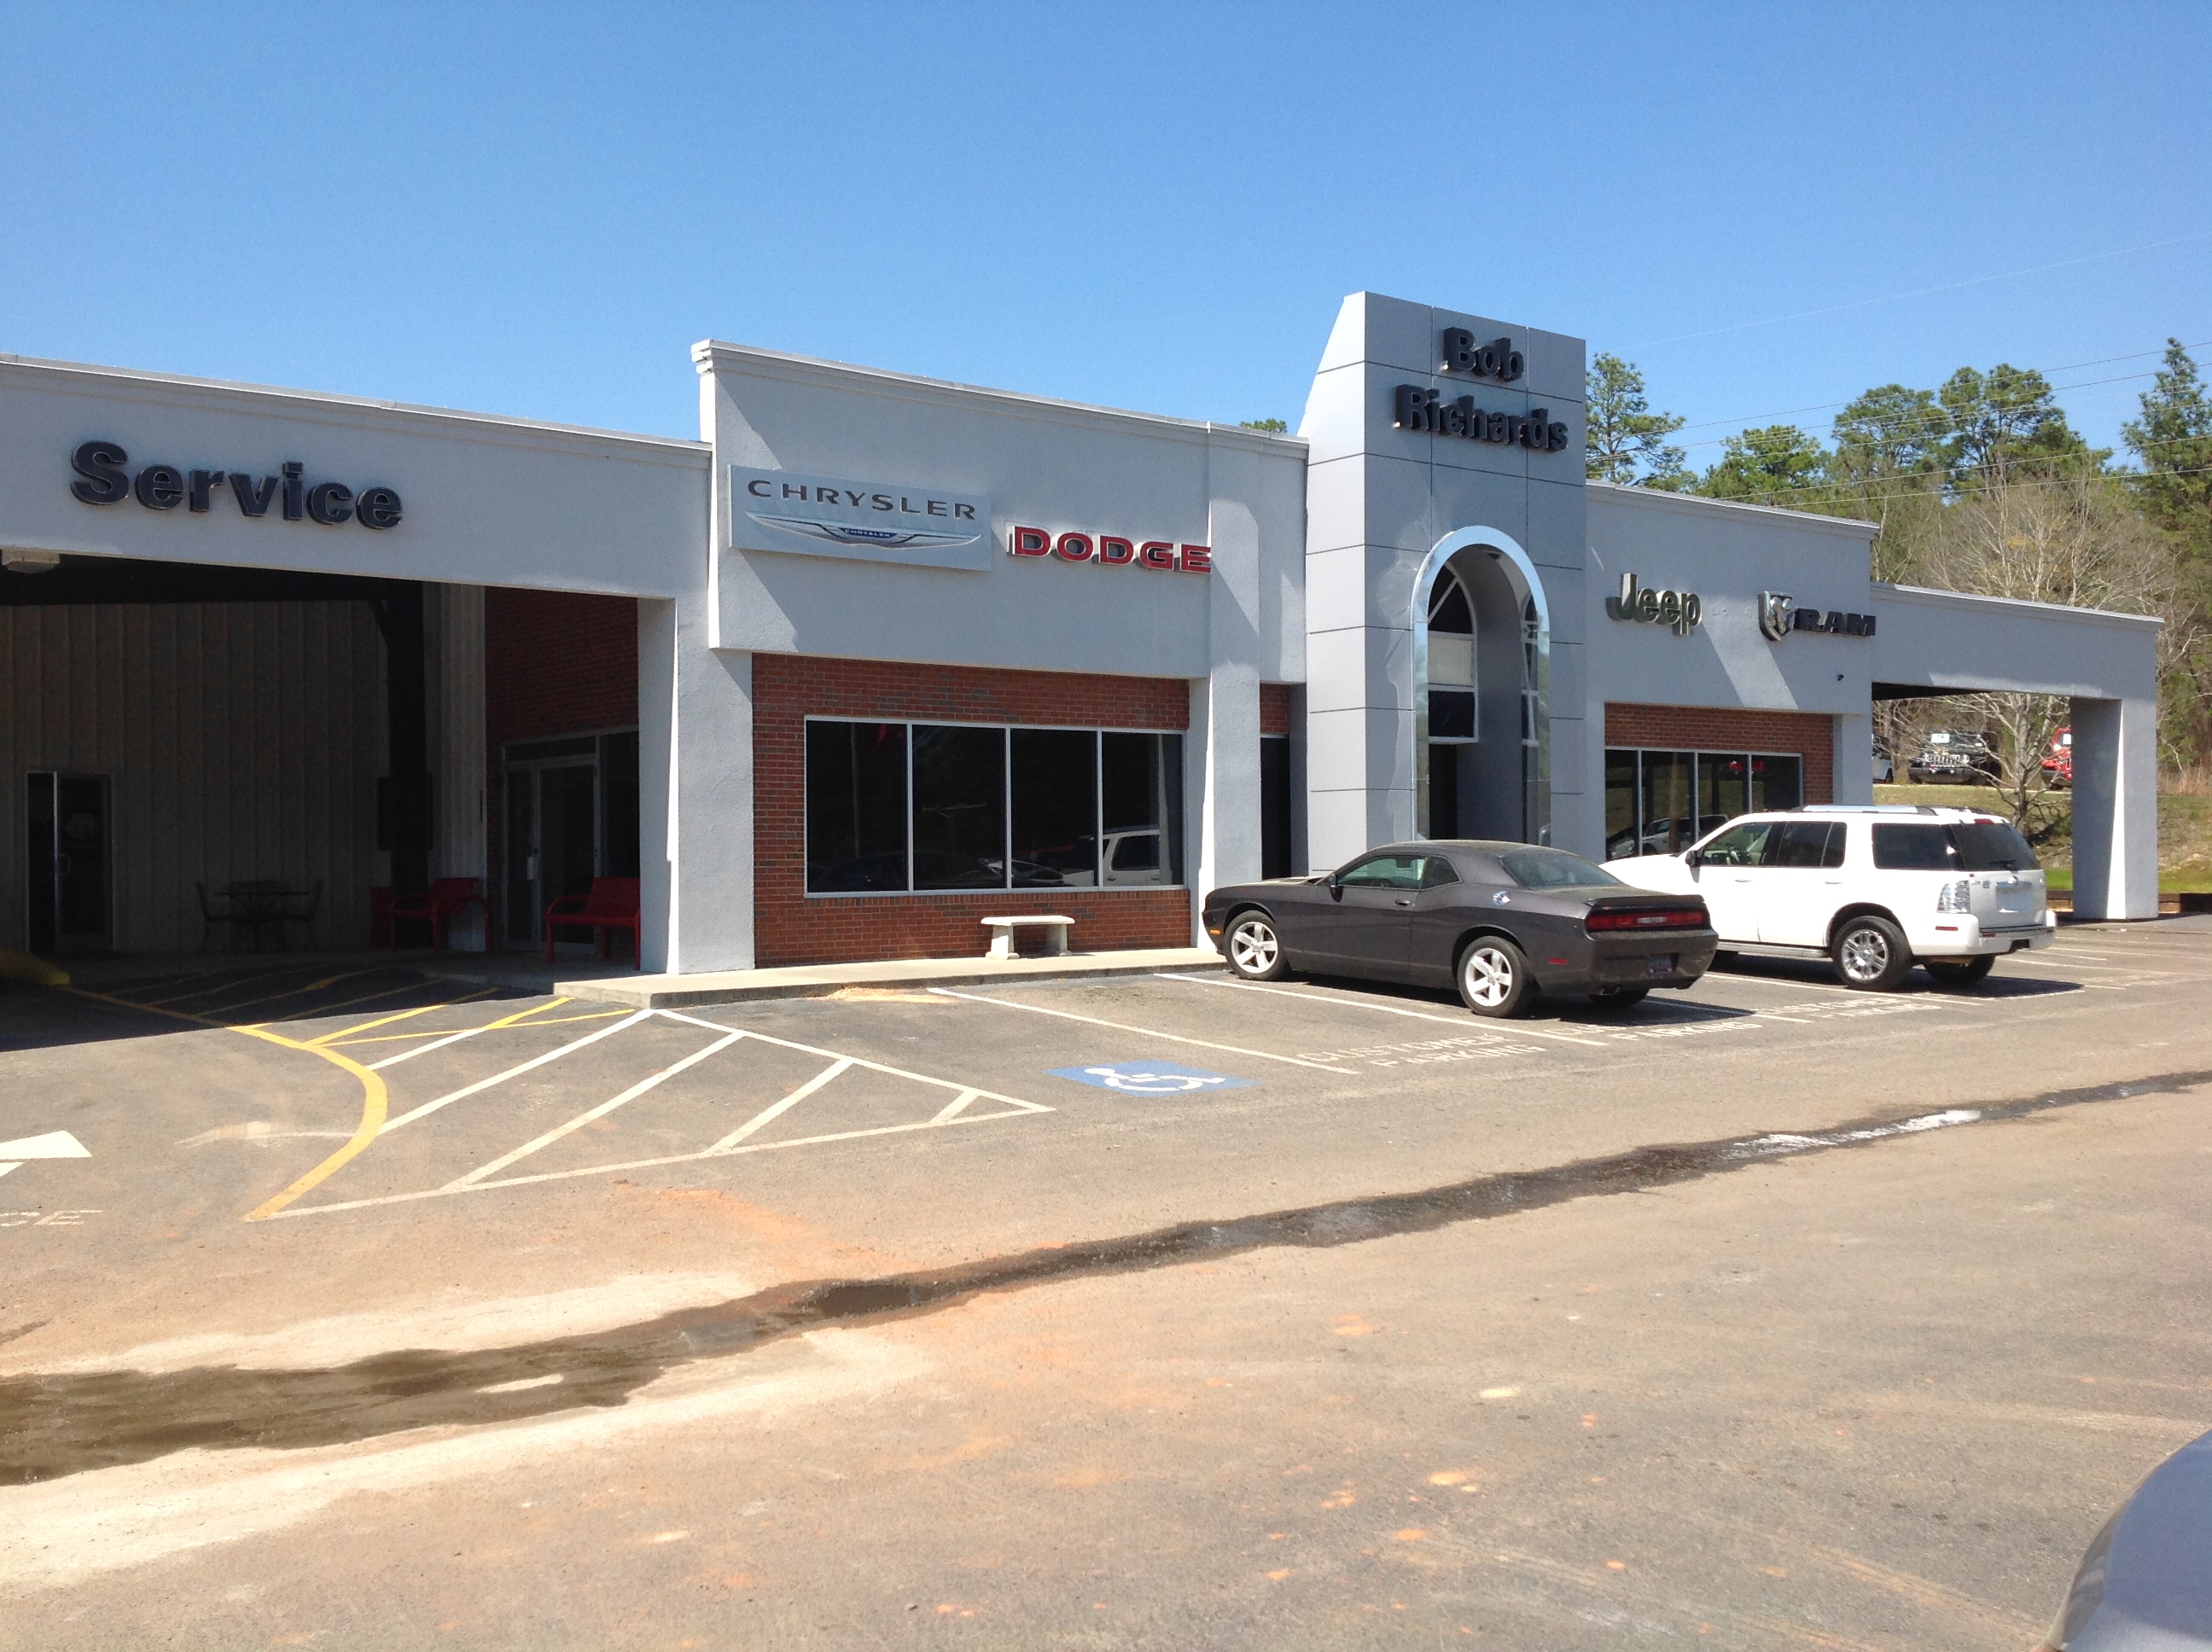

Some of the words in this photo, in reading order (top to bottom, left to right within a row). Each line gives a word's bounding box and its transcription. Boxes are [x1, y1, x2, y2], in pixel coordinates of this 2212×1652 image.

[1443, 327, 1524, 381] Bob
[1394, 384, 1569, 451] Richards
[70, 439, 404, 531] Service
[748, 479, 976, 521] CHRYSLER
[1009, 526, 1211, 573] DODGE
[1606, 573, 1703, 636] Jeep
[1793, 607, 1876, 637] RAM
[1296, 1033, 1517, 1062] CUSTOMER
[1607, 1021, 1762, 1041] PARKING
[1367, 1044, 1546, 1068] PARKING
